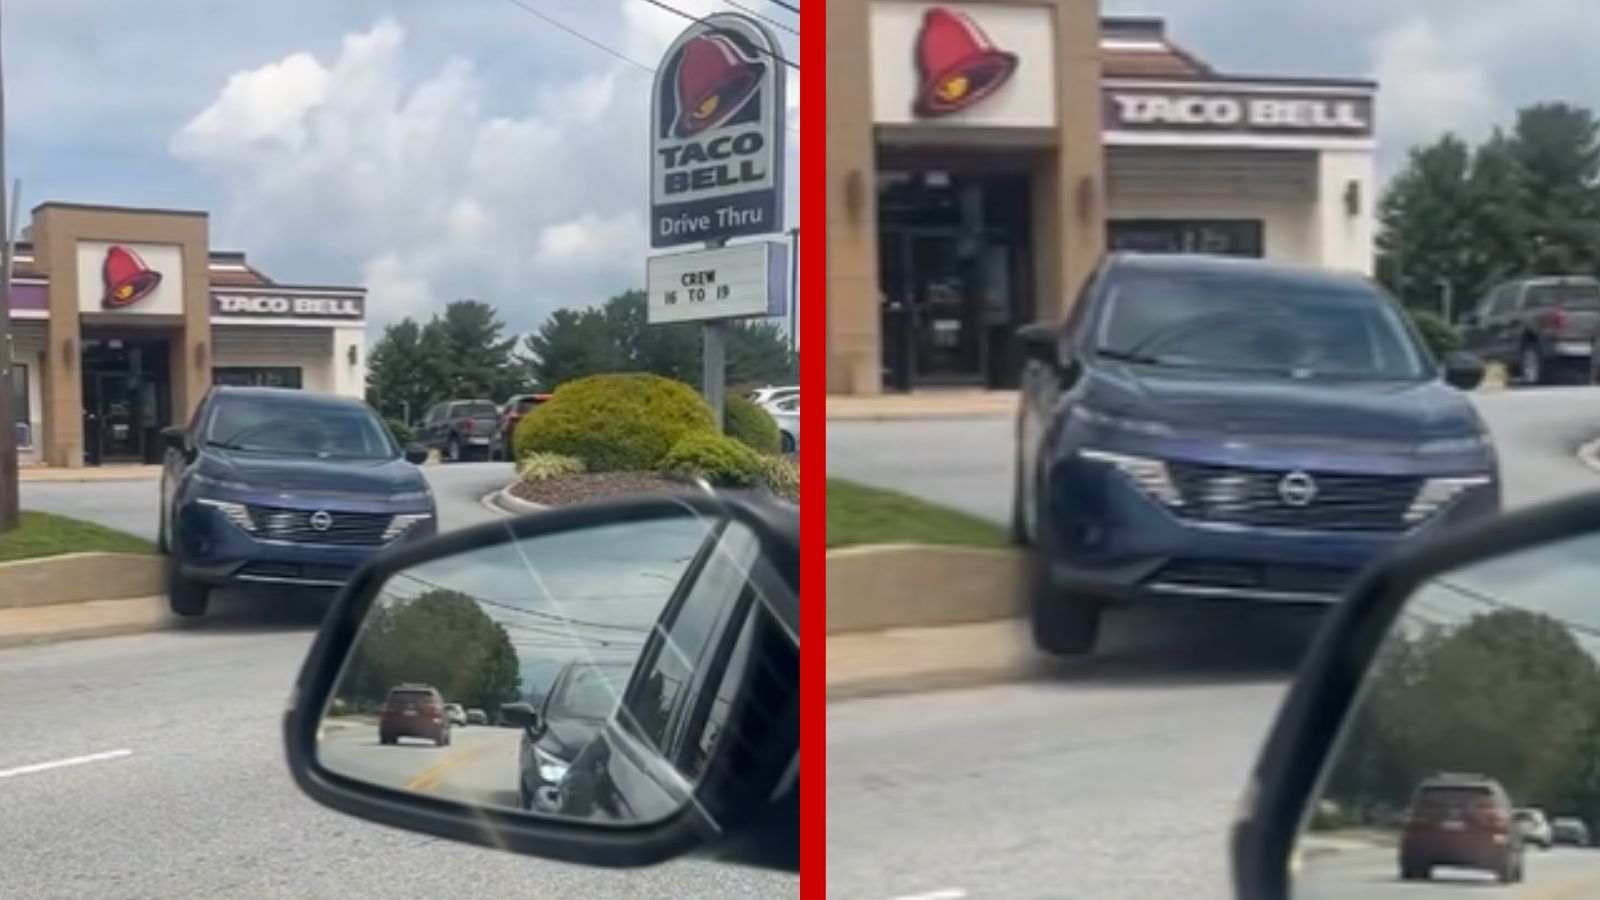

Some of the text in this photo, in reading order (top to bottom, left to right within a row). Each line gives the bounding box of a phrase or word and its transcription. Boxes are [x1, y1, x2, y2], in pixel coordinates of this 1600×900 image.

[1115, 94, 1365, 127] TACO BELL
[658, 132, 764, 168] TACO
[665, 161, 765, 194] BELL
[660, 206, 763, 235] Drive Thru
[681, 270, 716, 286] CREW
[217, 296, 360, 314] TACO BELL
[688, 287, 705, 301] TO
[717, 285, 730, 299] 19
